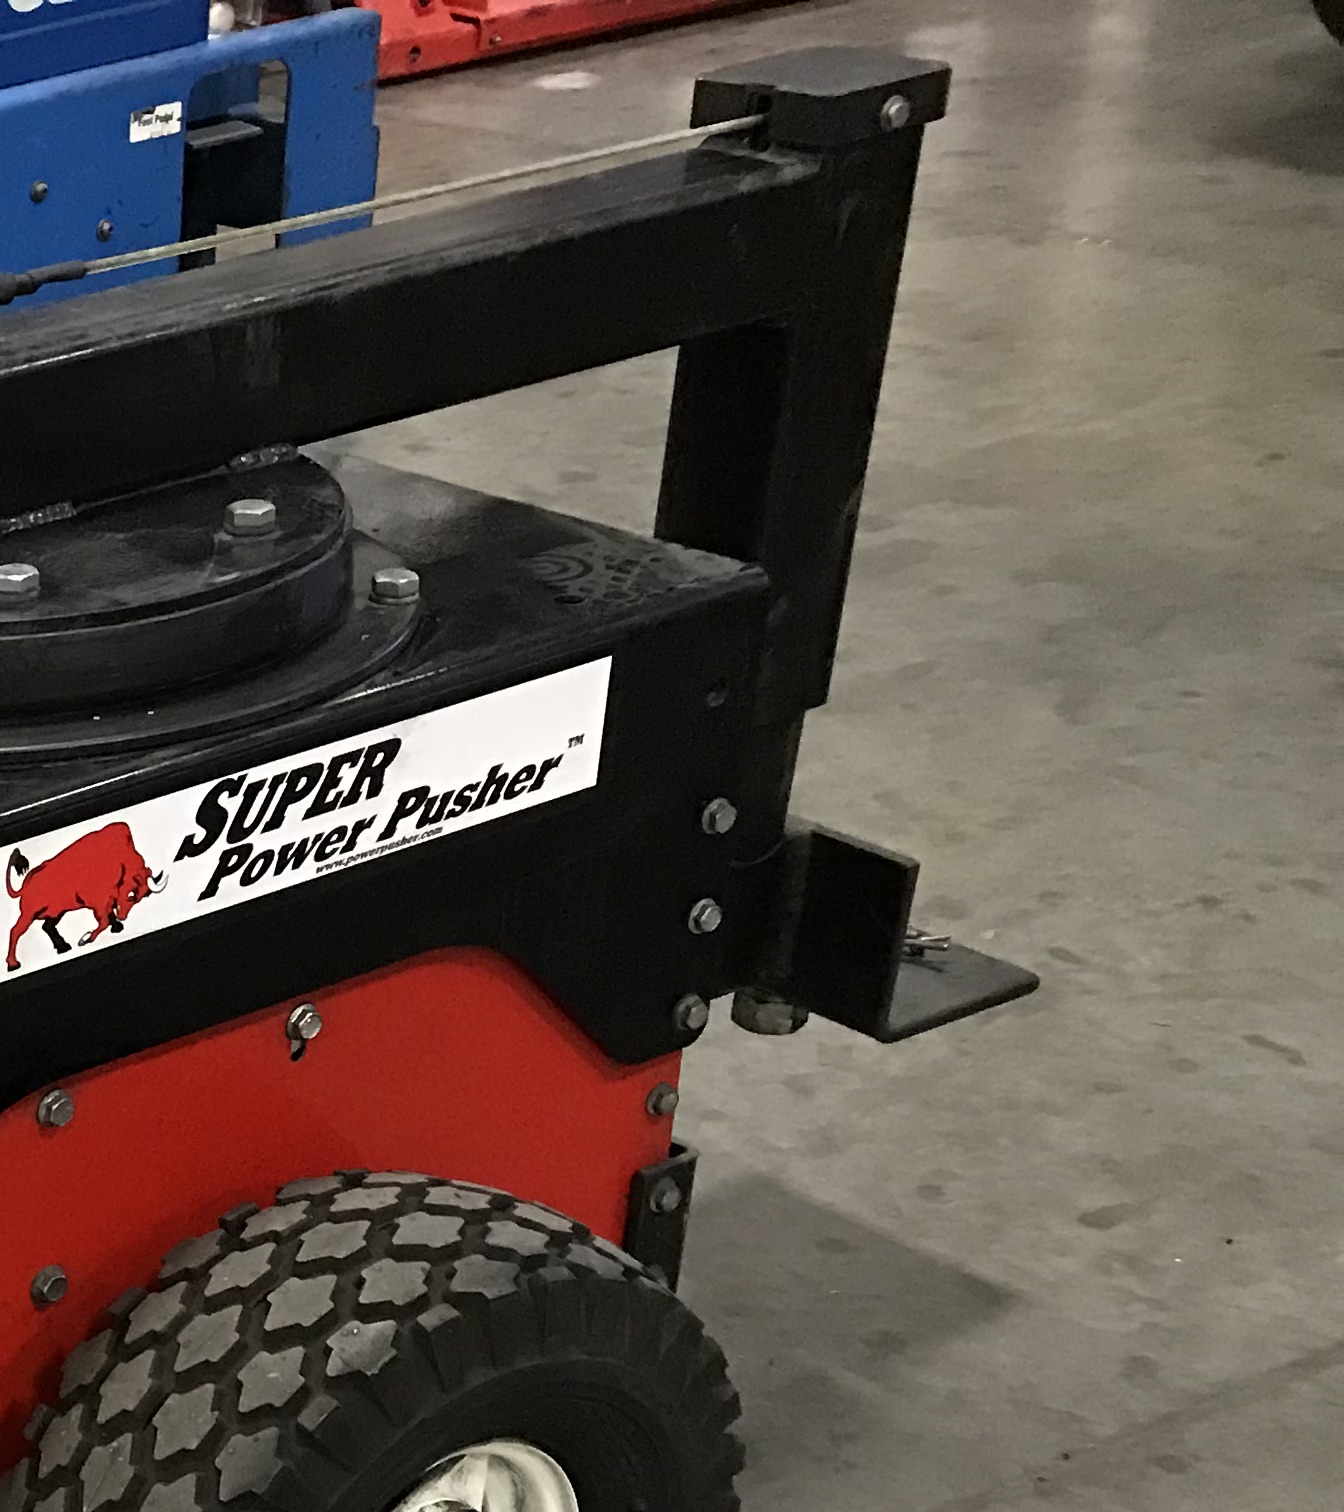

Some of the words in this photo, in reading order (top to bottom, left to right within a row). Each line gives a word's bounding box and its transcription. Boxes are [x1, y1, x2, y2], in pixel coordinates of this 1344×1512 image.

[173, 737, 403, 863] SUPER
[197, 814, 378, 903] Power
[376, 753, 564, 843] Pusher
[315, 826, 444, 875] www.powerpusher.com
